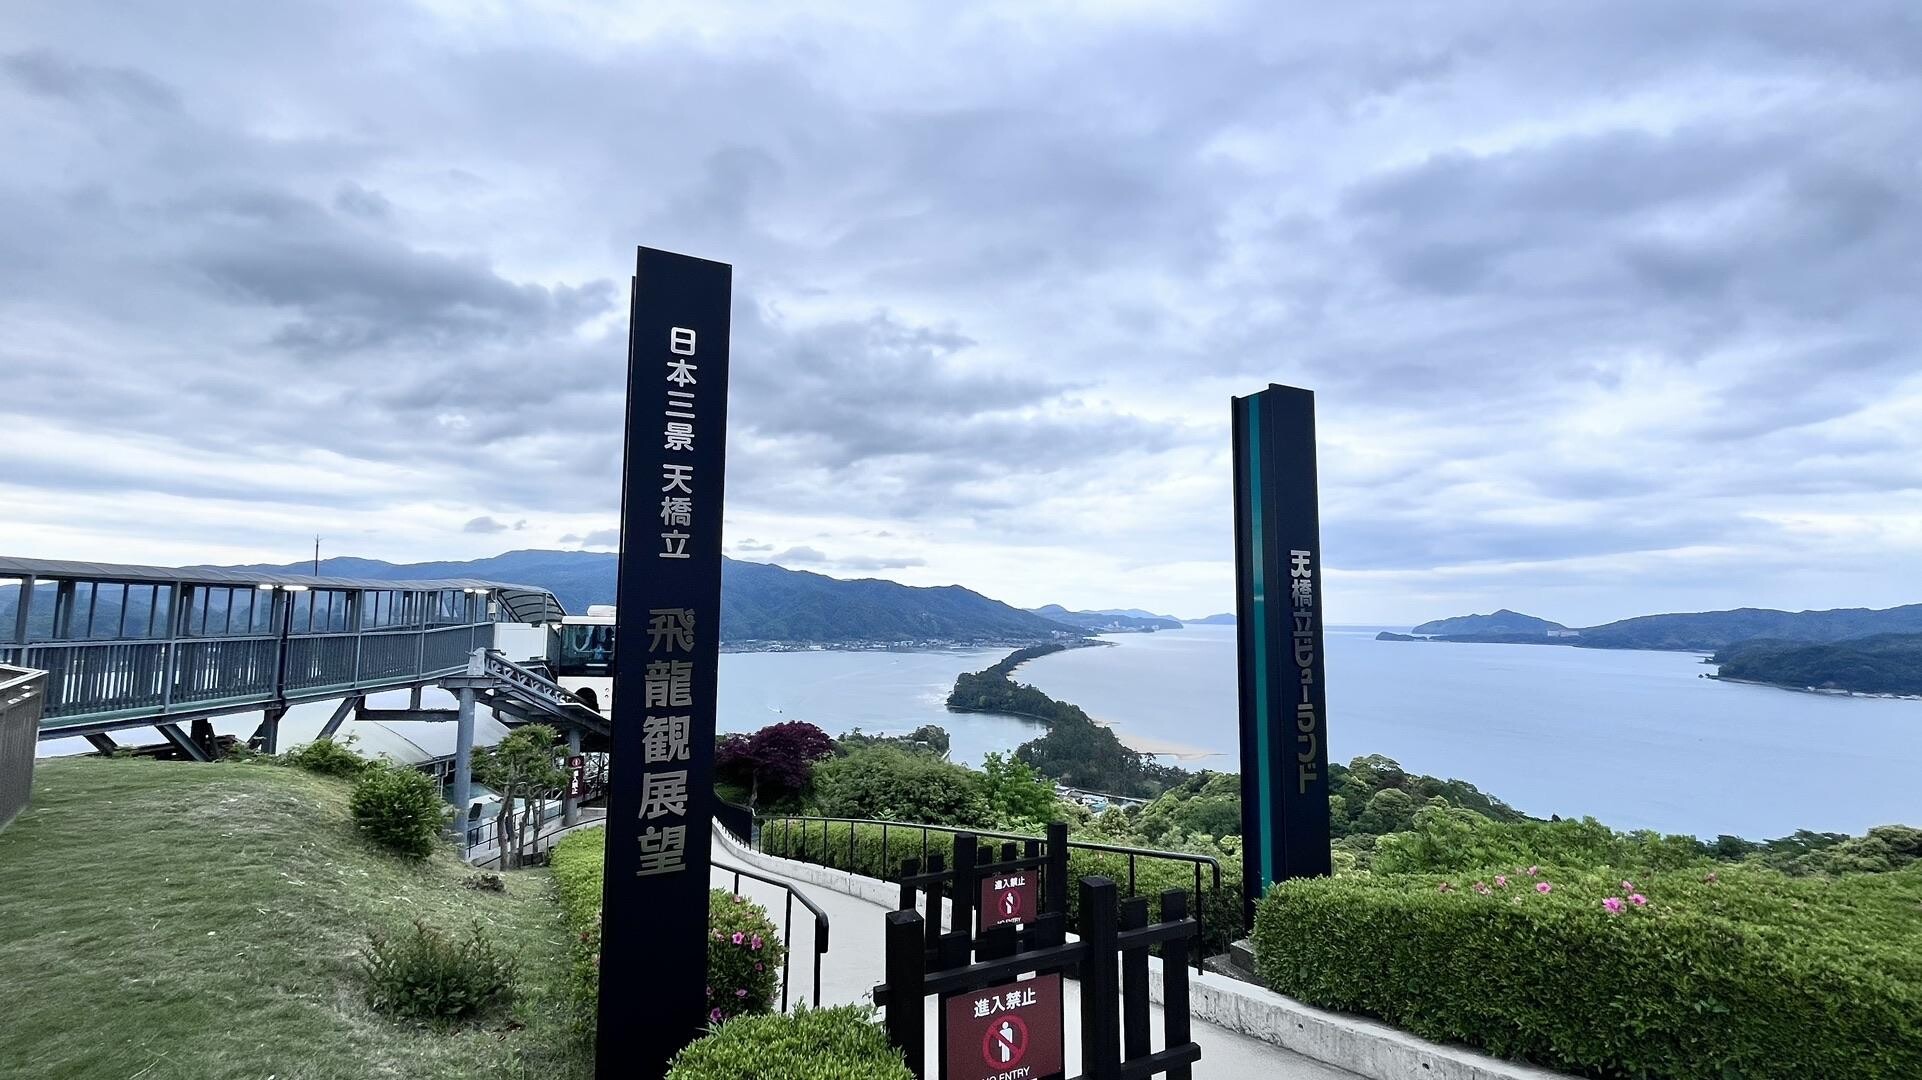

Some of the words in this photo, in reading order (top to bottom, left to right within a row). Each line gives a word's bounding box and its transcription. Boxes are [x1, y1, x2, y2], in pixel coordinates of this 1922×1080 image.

[664, 326, 698, 451] 日本三景
[659, 463, 694, 559] 天橋立
[1290, 549, 1317, 794] 天橋立ビューランド
[636, 607, 697, 877] 飛龍観展望
[994, 875, 1026, 890] 進入禁止
[973, 987, 1037, 1018] 進入禁止
[999, 1065, 1030, 1080] ENTRY
